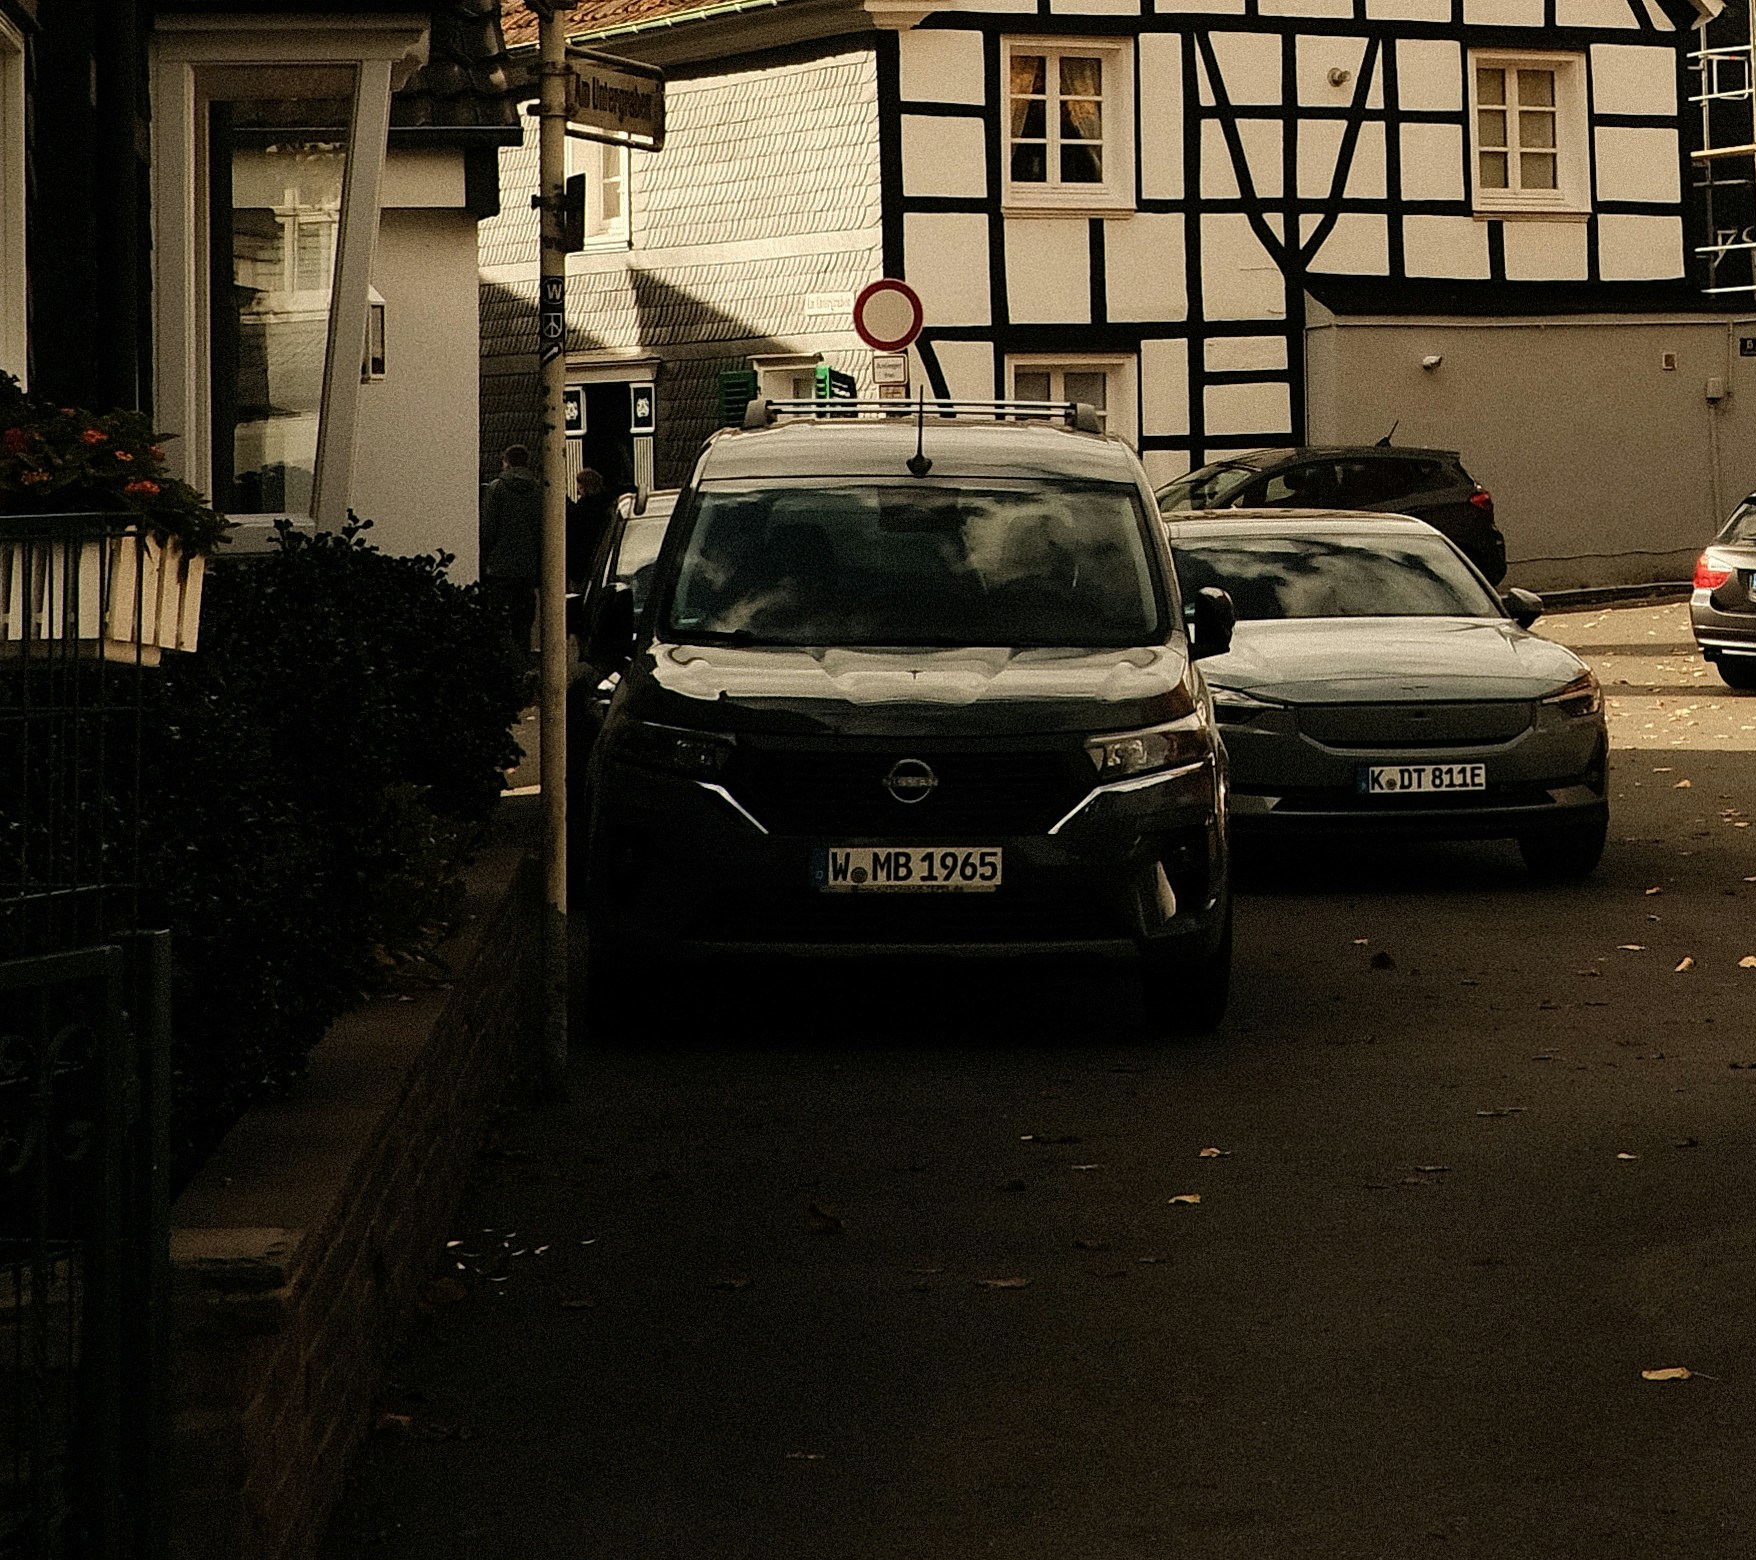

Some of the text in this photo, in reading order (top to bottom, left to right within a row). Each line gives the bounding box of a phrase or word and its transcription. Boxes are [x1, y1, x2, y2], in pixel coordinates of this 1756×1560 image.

[547, 284, 562, 300] W
[1371, 766, 1483, 790] K DT 811E
[831, 851, 998, 881] W MB 1965
